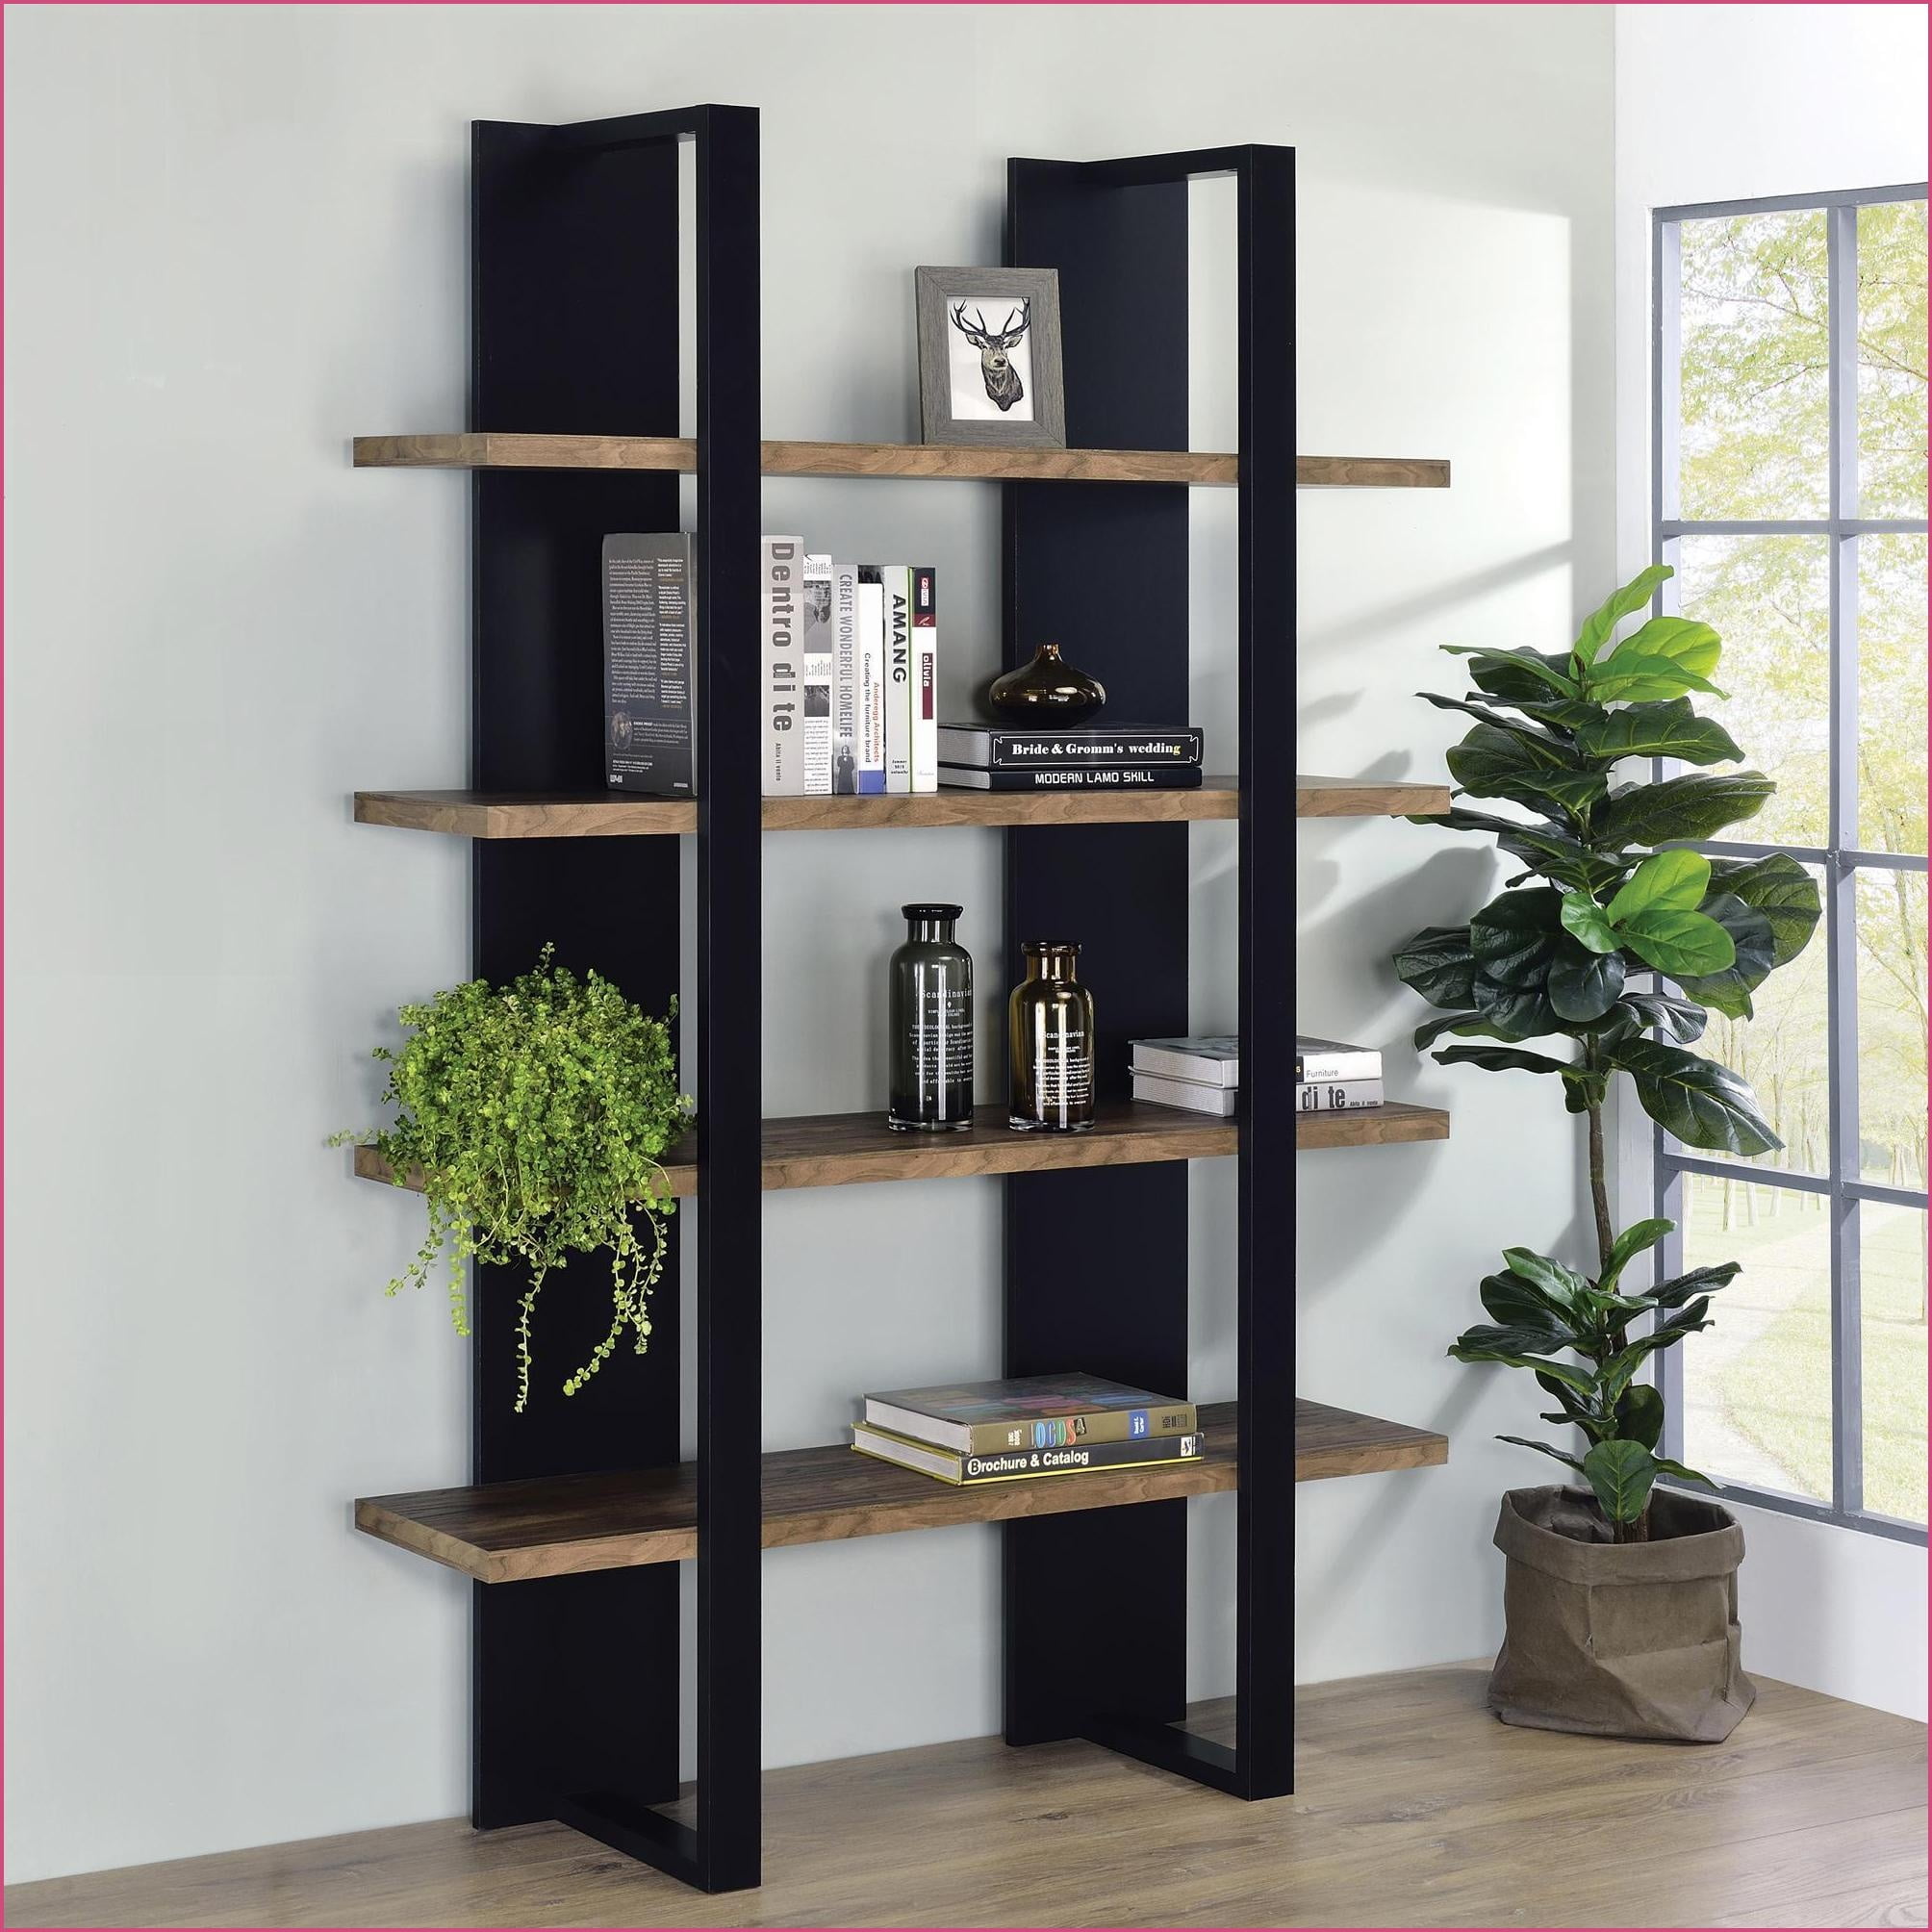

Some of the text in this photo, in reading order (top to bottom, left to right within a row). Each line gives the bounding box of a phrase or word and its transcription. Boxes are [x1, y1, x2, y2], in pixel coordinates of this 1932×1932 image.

[772, 543, 796, 731] Dentro di te
[893, 594, 906, 683] AMANG
[839, 573, 852, 738] CREATE WONDERFUL HOMELIFE
[924, 655, 932, 687] olivia
[1012, 743, 1181, 755] Bride & Gromm's wedding
[1034, 773, 1083, 784] MODERN
[1123, 772, 1155, 782] SKILL
[1307, 1069, 1339, 1078] Furniture
[1302, 1086, 1345, 1110] di te
[967, 1450, 1089, 1476] Brochure & Catalog
